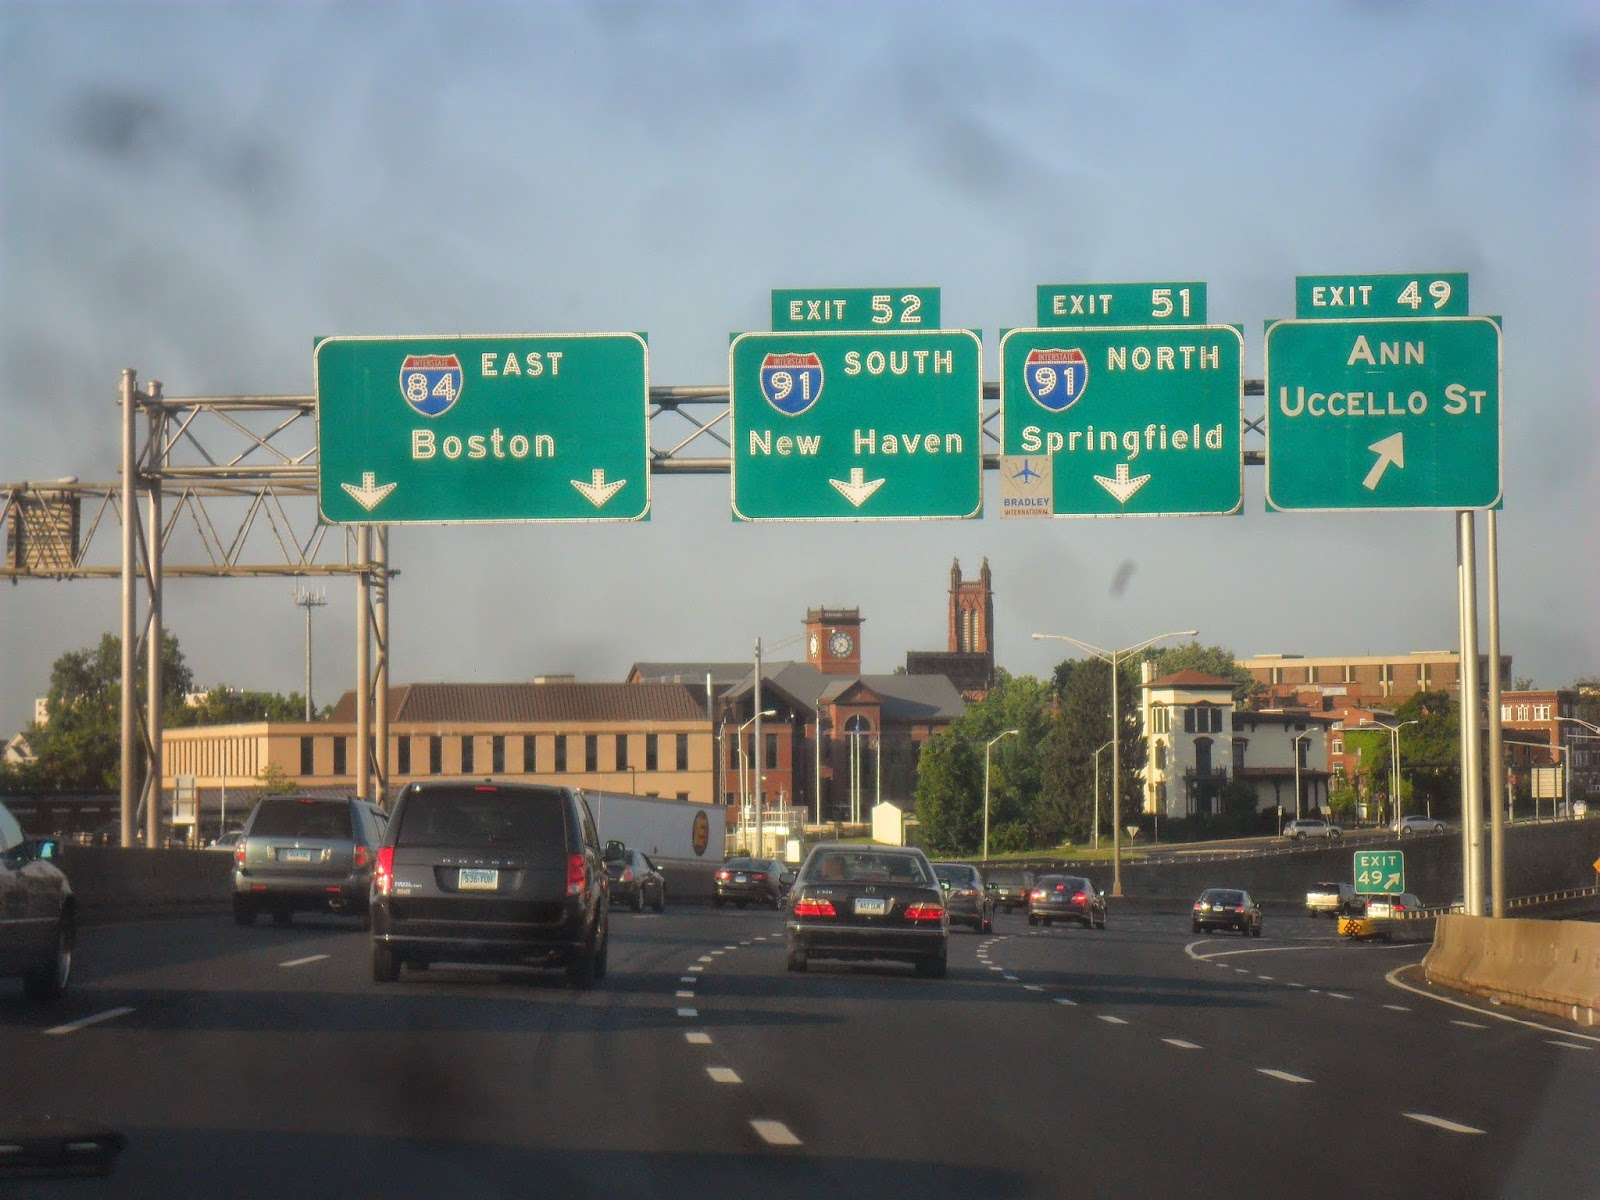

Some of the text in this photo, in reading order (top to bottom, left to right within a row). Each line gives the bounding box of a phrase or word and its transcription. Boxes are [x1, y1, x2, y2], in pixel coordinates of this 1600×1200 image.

[1053, 288, 1190, 318] EXIT 51
[1313, 280, 1451, 310] EXIT 49
[789, 294, 922, 324] EXIT 52
[413, 358, 448, 367] INTERSTATE
[481, 351, 563, 377] EAST
[773, 356, 810, 366] INTERSTATE
[844, 350, 953, 376] SOUTH
[1037, 352, 1074, 361] INTERSTATE
[1108, 345, 1220, 371] NORTH
[406, 373, 457, 402] 84
[771, 371, 810, 400] 91
[1034, 366, 1075, 396] 91
[411, 427, 556, 460] Boston
[749, 428, 964, 456] New Haven
[1021, 422, 1223, 461] Springfield
[1004, 498, 1050, 506] BRADLEY
[1361, 856, 1397, 867] EXIT
[1358, 870, 1383, 885] 49
